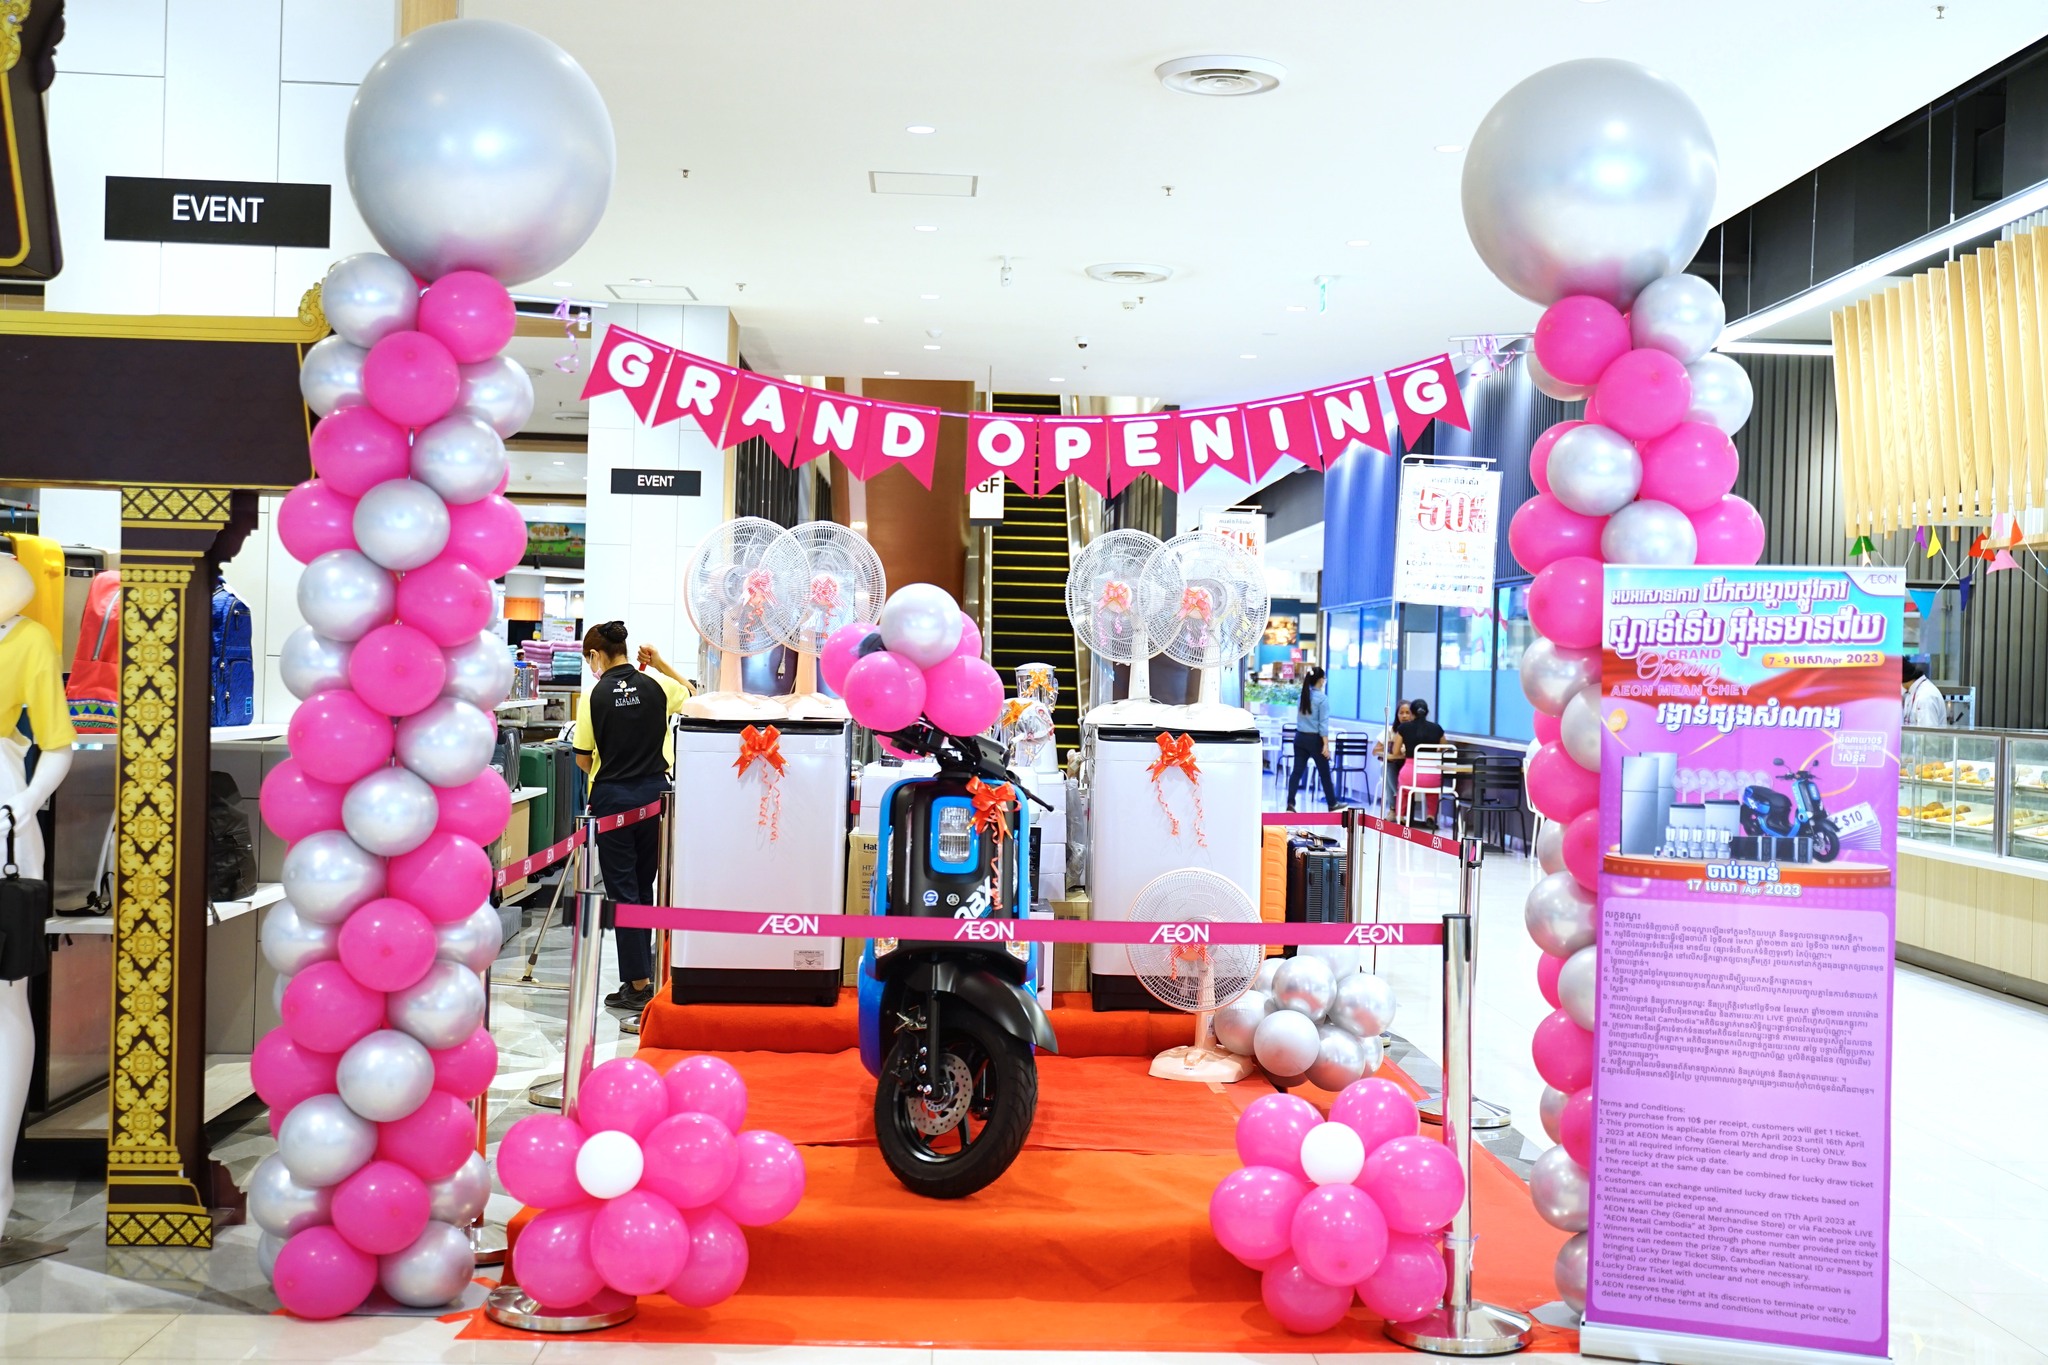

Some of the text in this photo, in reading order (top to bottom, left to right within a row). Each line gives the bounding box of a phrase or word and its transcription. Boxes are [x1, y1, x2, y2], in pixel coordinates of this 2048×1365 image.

[172, 194, 265, 223] EVENT
[608, 341, 1447, 471] GRAND OPENING
[637, 474, 675, 487] EVENT
[1667, 649, 1722, 659] GRAND
[1769, 657, 1775, 665] 7
[1784, 656, 1790, 664] 9
[1846, 654, 1879, 664] 2023
[1636, 650, 1722, 687] Opening
[1610, 684, 1752, 696] AEON MEAN CHEY
[1842, 810, 1863, 826] $10
[1687, 880, 1702, 890] 17
[1766, 883, 1801, 896] 2023
[1634, 1014, 1656, 1022] Retail
[1601, 1098, 1622, 1107] Terms
[1606, 1108, 1626, 1120] Every
[1629, 1112, 1664, 1121] purchase
[1667, 1114, 1685, 1122] from
[1688, 1116, 1701, 1124] 10$
[1752, 1123, 1794, 1132] customers
[1814, 1128, 1826, 1136] get
[1607, 1118, 1621, 1126] This
[1624, 1122, 1664, 1130] promotion
[1676, 1125, 1716, 1135] applicable
[1719, 1128, 1738, 1136] from
[1741, 1130, 1758, 1138] 07th
[1762, 1132, 1780, 1142] April
[1783, 1133, 1802, 1142] 2023
[1826, 1137, 1842, 1145] 16th
[1846, 1139, 1864, 1149] April
[1607, 1127, 1624, 1136] 2023
[1637, 1130, 1658, 1139] AEON
[1661, 1132, 1682, 1141] Mean
[1685, 1134, 1703, 1145] Chey
[1707, 1136, 1739, 1146] (General
[1742, 1140, 1792, 1151] Merchandise
[1796, 1144, 1820, 1156] Store)
[1640, 1141, 1672, 1150] required
[1675, 1143, 1720, 1154] information
[1724, 1148, 1750, 1159] clearly
[1770, 1152, 1788, 1163] drop
[1801, 1155, 1825, 1166] Lucky
[1828, 1157, 1849, 1166] Draw
[1852, 1159, 1866, 1167] Box
[1606, 1146, 1629, 1156] before
[1632, 1149, 1652, 1160] lucky
[1656, 1151, 1674, 1160] draw
[1677, 1154, 1693, 1163] pick
[1696, 1157, 1706, 1165] up
[1606, 1156, 1618, 1164] The
[1622, 1159, 1648, 1169] receipt
[1701, 1165, 1714, 1175] day
[1733, 1168, 1743, 1176] be
[1746, 1171, 1786, 1180] combined
[1788, 1173, 1799, 1181] for
[1802, 1174, 1824, 1186] lucky
[1827, 1177, 1847, 1186] draw
[1850, 1179, 1873, 1188] ticket
[1605, 1175, 1645, 1186] Customers
[1665, 1182, 1701, 1193] exchange
[1704, 1185, 1742, 1195] unlimited
[1745, 1188, 1766, 1200] lucky
[1769, 1191, 1788, 1200] draw
[1791, 1193, 1818, 1203] tickets
[1821, 1196, 1846, 1205] based
[1605, 1186, 1627, 1194] actual
[1630, 1189, 1680, 1199] accumulated
[1604, 1203, 1624, 1212] AEON
[1628, 1206, 1648, 1215] Mean
[1651, 1208, 1670, 1219] Chey
[1673, 1210, 1705, 1220] (General
[1708, 1214, 1758, 1226] Merchandise
[1761, 1219, 1785, 1231] Store)
[1813, 1224, 1852, 1235] Facebook
[1855, 1229, 1872, 1238] LIVE
[1605, 1194, 1635, 1204] Winners
[1654, 1199, 1663, 1207] be
[1666, 1200, 1692, 1210] picked
[1695, 1205, 1704, 1213] up
[1725, 1208, 1769, 1217] announced
[1785, 1211, 1800, 1220] 17th
[1803, 1213, 1822, 1224] April
[1825, 1216, 1844, 1224] 2023
